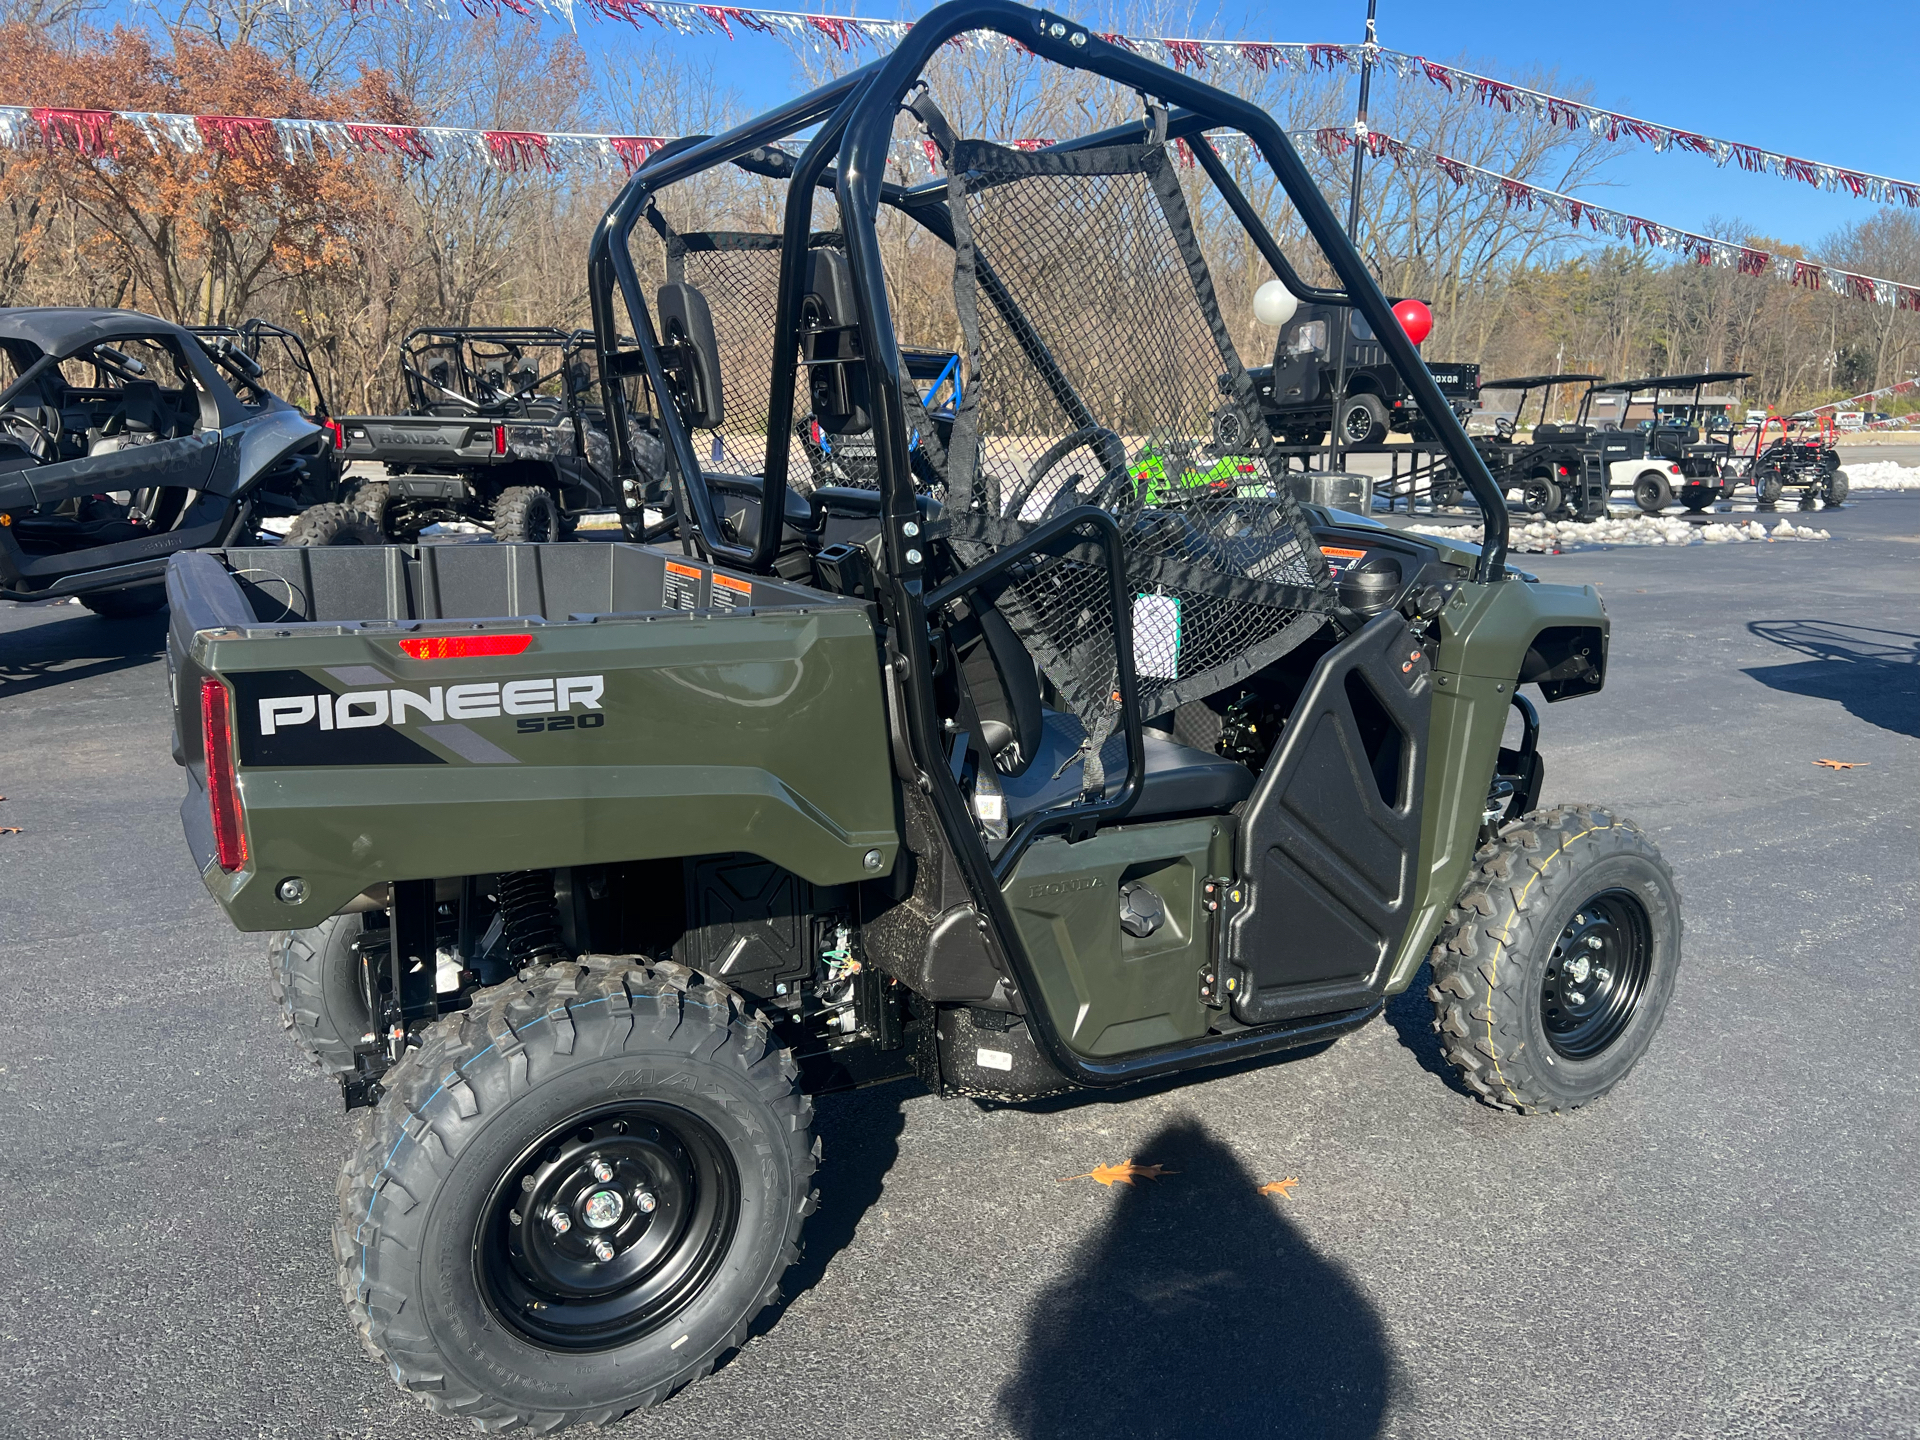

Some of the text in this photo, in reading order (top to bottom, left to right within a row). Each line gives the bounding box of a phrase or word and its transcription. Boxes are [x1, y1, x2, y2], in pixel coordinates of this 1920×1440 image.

[378, 432, 450, 445] HONDA
[140, 536, 183, 553] SEGWAY
[258, 675, 604, 735] PIONEER
[516, 713, 604, 734] 520
[1028, 876, 1107, 898] HONDA
[607, 1068, 780, 1190] MAXXIS
[443, 1302, 467, 1339] NHS
